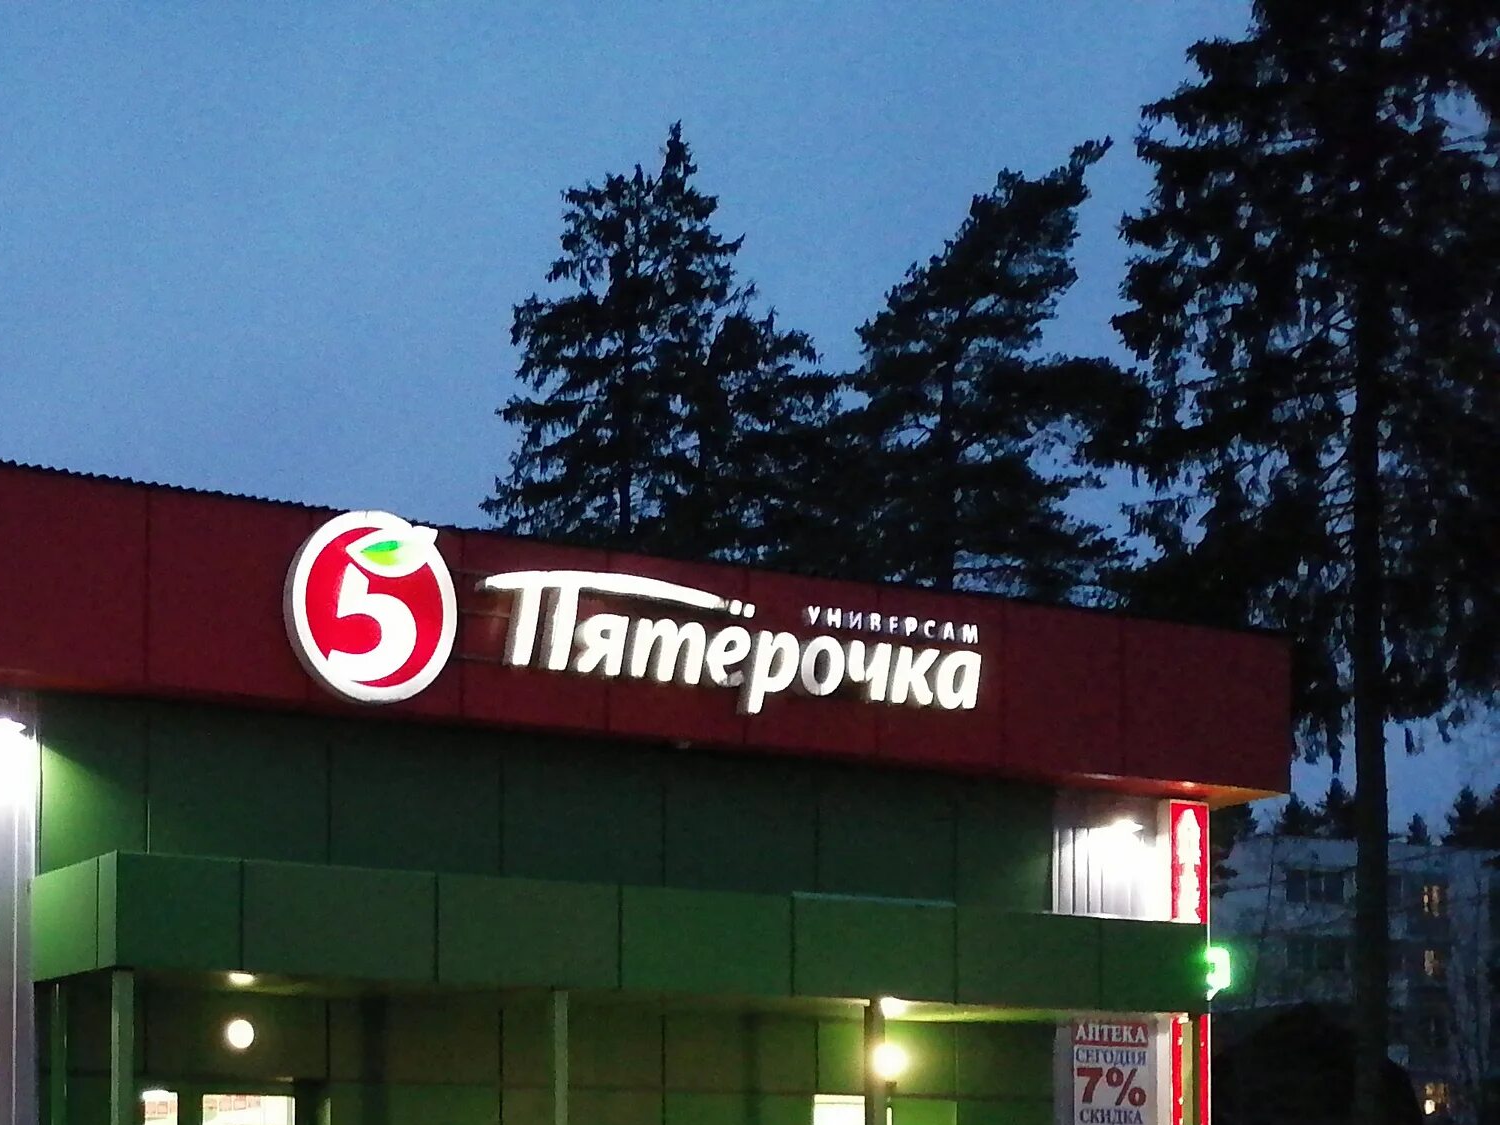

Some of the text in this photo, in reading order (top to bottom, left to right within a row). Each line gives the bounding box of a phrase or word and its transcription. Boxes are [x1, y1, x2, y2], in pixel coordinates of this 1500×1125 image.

[320, 545, 420, 684] 5
[807, 605, 979, 644] УНИВЕРСАМ
[484, 570, 982, 714] Пятёрочка
[1075, 1023, 1147, 1043] АПТЕКА
[1075, 1047, 1147, 1067] СЕГОДНЯ
[1076, 1067, 1147, 1107] 7%
